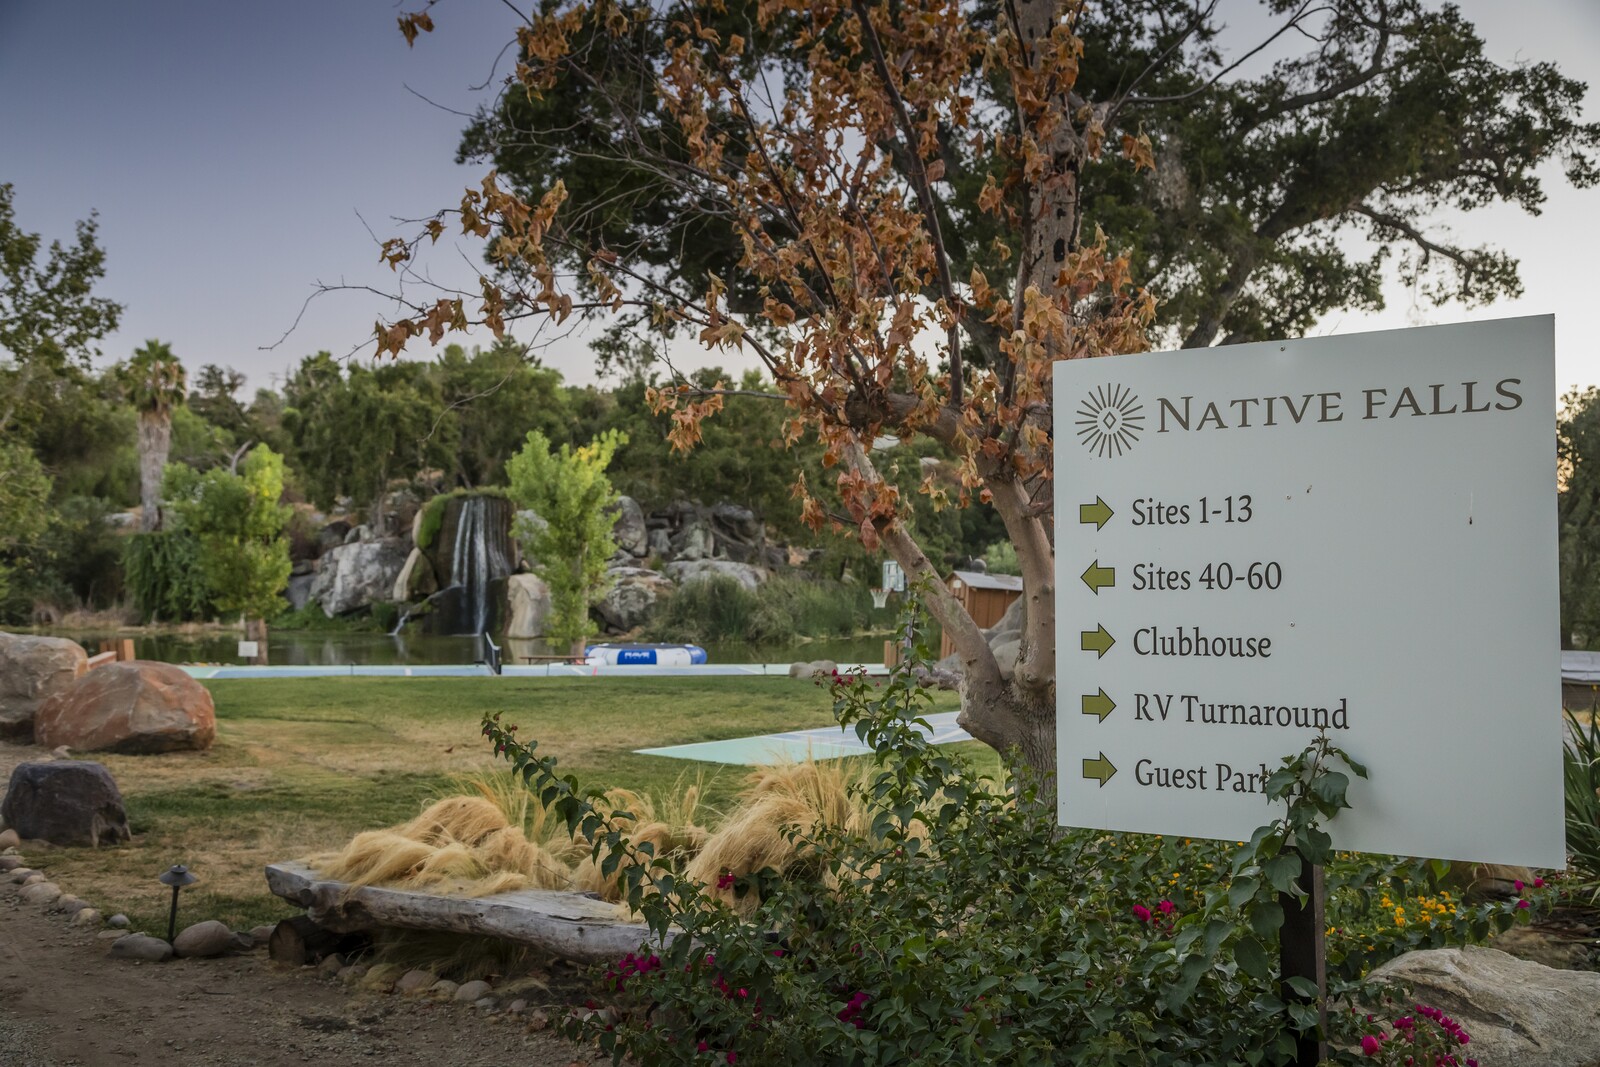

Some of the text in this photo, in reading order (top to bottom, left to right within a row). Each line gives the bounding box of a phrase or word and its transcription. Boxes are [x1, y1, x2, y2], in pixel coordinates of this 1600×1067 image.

[1156, 378, 1523, 433] NATIVE FALLS
[1131, 494, 1253, 526] Sites 1-13
[1132, 561, 1283, 591] Sites 40-60
[1133, 626, 1272, 658] Clubhouse
[1133, 693, 1350, 730] RV Turnaround
[1134, 759, 1207, 790] Guest
